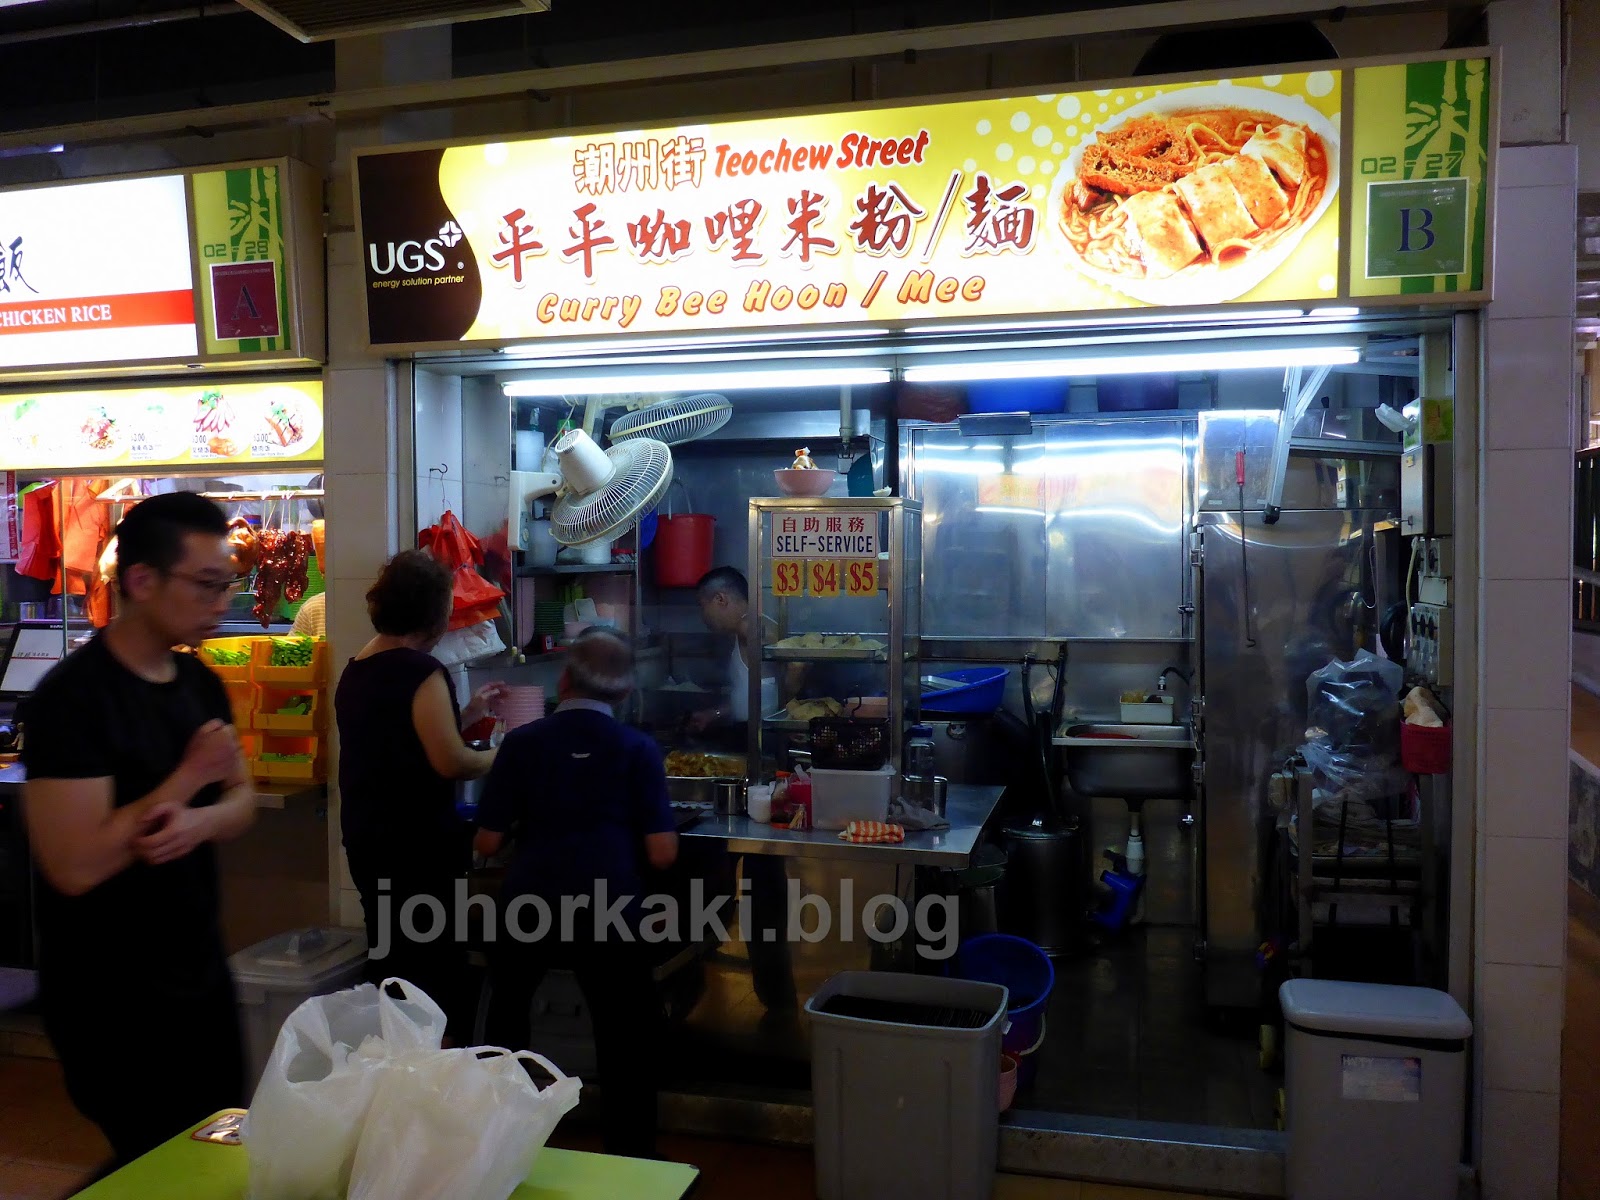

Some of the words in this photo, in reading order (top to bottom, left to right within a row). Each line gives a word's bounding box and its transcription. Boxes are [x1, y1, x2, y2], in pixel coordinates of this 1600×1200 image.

[573, 136, 706, 195] 潮州街
[715, 138, 833, 177] Teochew
[836, 130, 930, 169] Street
[1396, 207, 1436, 252] B
[369, 238, 446, 275] UGS
[372, 279, 400, 289] energy
[402, 277, 433, 287] solution
[434, 275, 465, 286] partner
[536, 292, 642, 328] Curry
[655, 285, 728, 317] Bee
[743, 279, 848, 313] Hoon
[897, 269, 986, 305] Mee
[0, 307, 66, 328] HICKEN
[70, 304, 112, 323] RICE
[231, 284, 262, 320] A
[782, 516, 865, 533] 自助服務
[776, 535, 873, 553] SELF-SERVICE
[776, 562, 800, 593] $3
[813, 562, 837, 594] $4
[850, 562, 874, 593] $5
